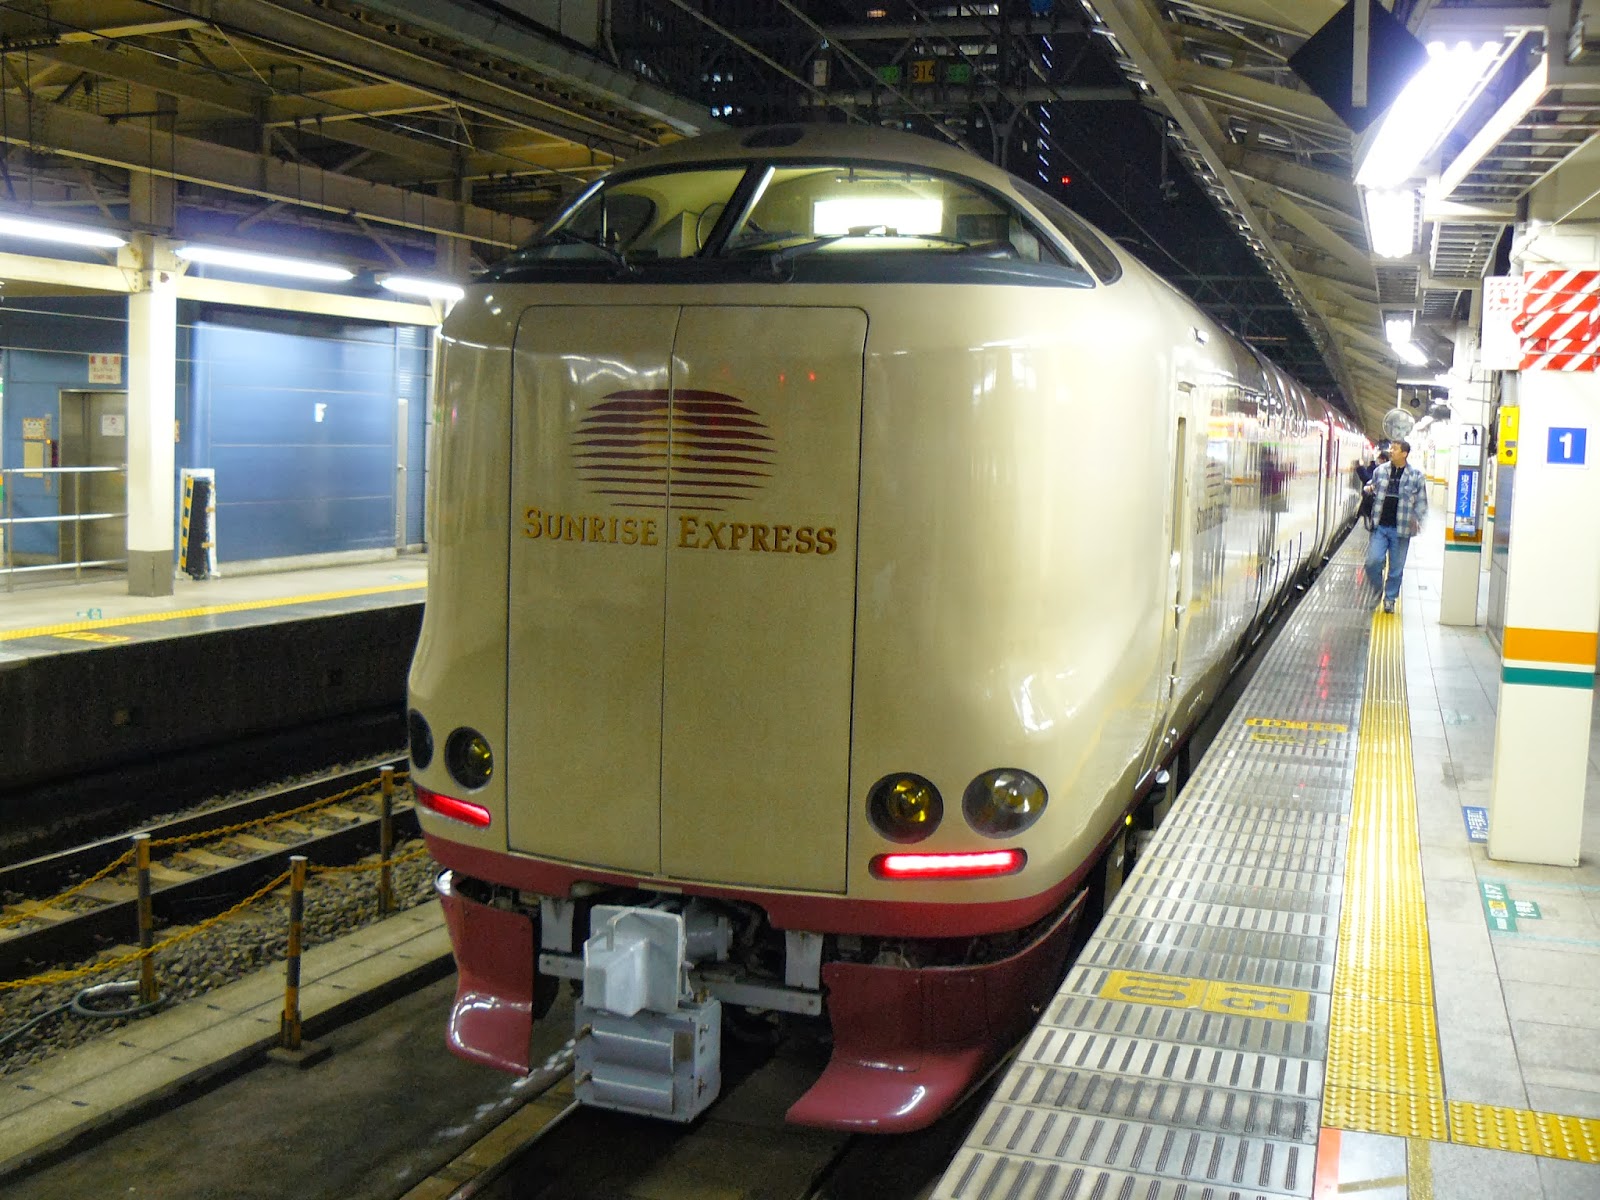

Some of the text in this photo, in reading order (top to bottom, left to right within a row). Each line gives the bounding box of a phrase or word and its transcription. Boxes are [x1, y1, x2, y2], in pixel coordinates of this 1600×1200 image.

[1559, 432, 1573, 459] 1
[521, 506, 839, 556] SUNRISE EXPRESS
